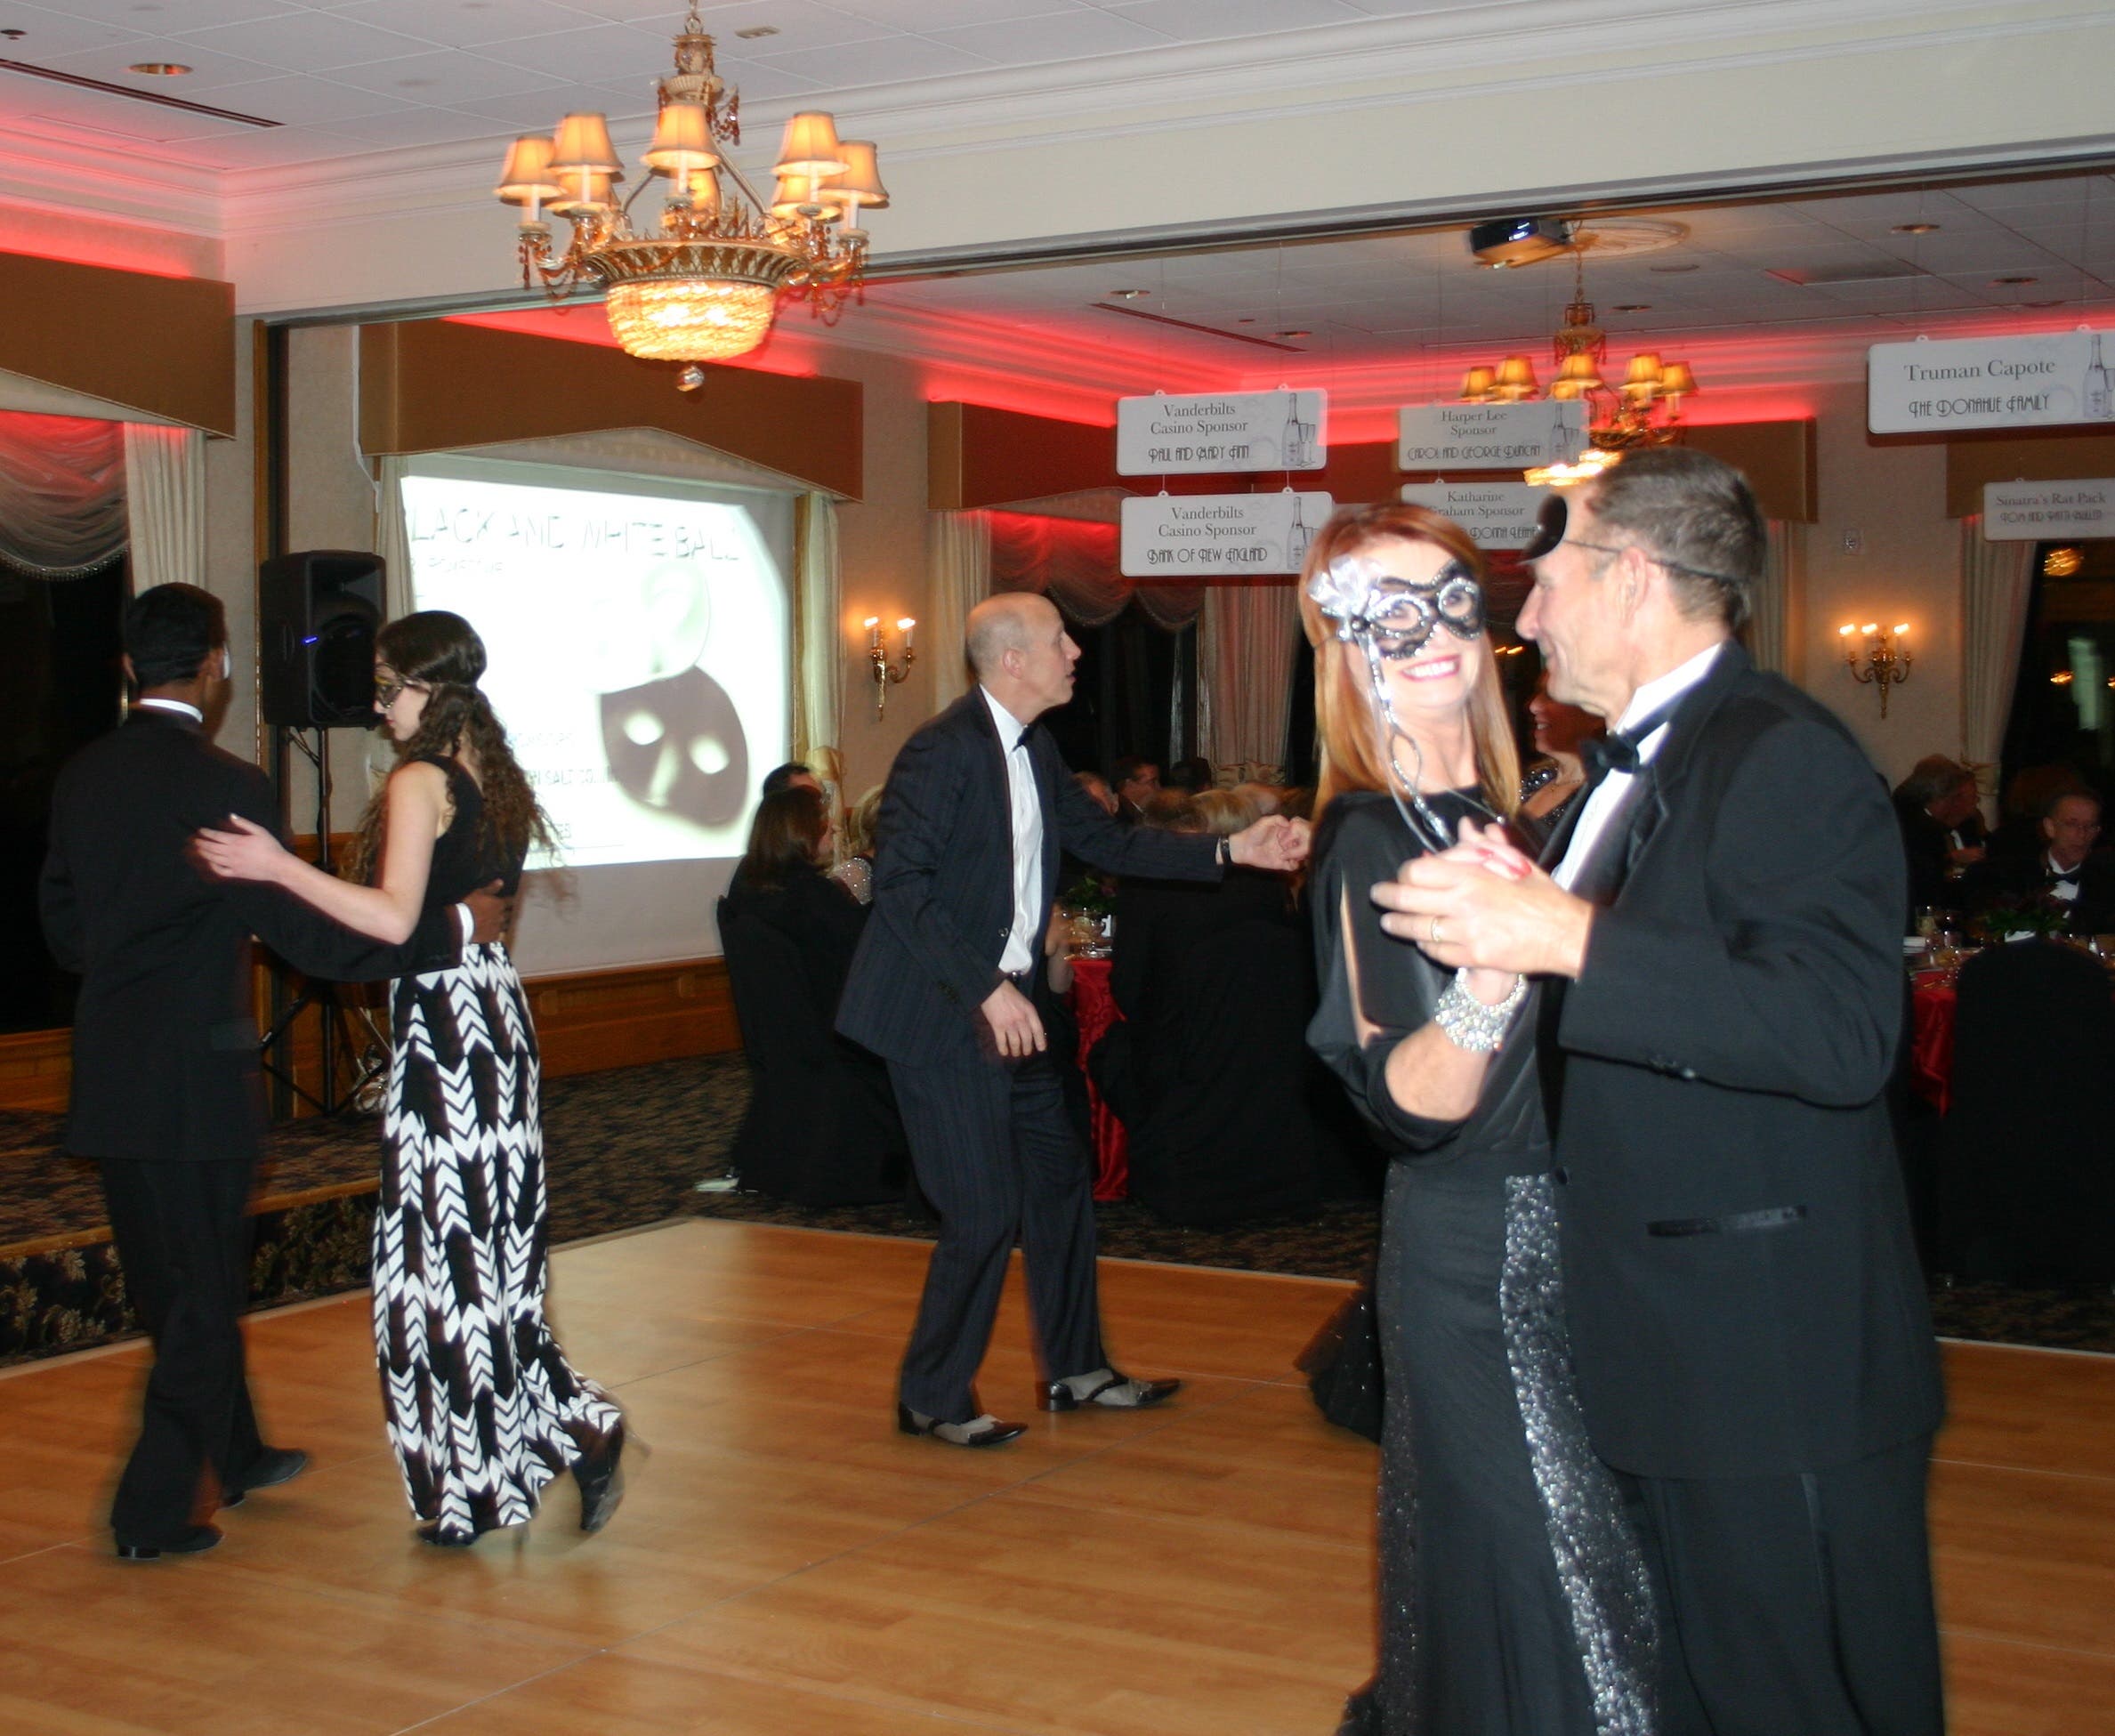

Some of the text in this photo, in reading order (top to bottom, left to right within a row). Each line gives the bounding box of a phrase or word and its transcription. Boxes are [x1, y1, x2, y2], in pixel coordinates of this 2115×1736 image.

[1903, 359, 2056, 382] Truman Capote
[1164, 402, 1236, 417] Vanderbilts
[1909, 400, 1933, 418] THE
[2006, 394, 2050, 415] FAMILY
[1441, 409, 1508, 424] Harper Lee
[1150, 420, 1248, 436] Casino Sponsor
[1450, 424, 1497, 439] Sponsor
[1175, 447, 1193, 461] AND
[1442, 447, 1458, 460] AND
[1461, 445, 1501, 460] GEORGE
[1447, 490, 1505, 503] Katharine
[1995, 491, 2106, 506] Sinatra's Rat Pack
[1172, 505, 1244, 520] Vanderbilts
[1478, 505, 1525, 519] Sponsor
[410, 507, 495, 543] LACK
[1158, 522, 1257, 539] Casino Sponsor
[1147, 548, 1175, 565] BANK
[1177, 548, 1195, 563] OF
[1225, 547, 1268, 562] ENGLAND
